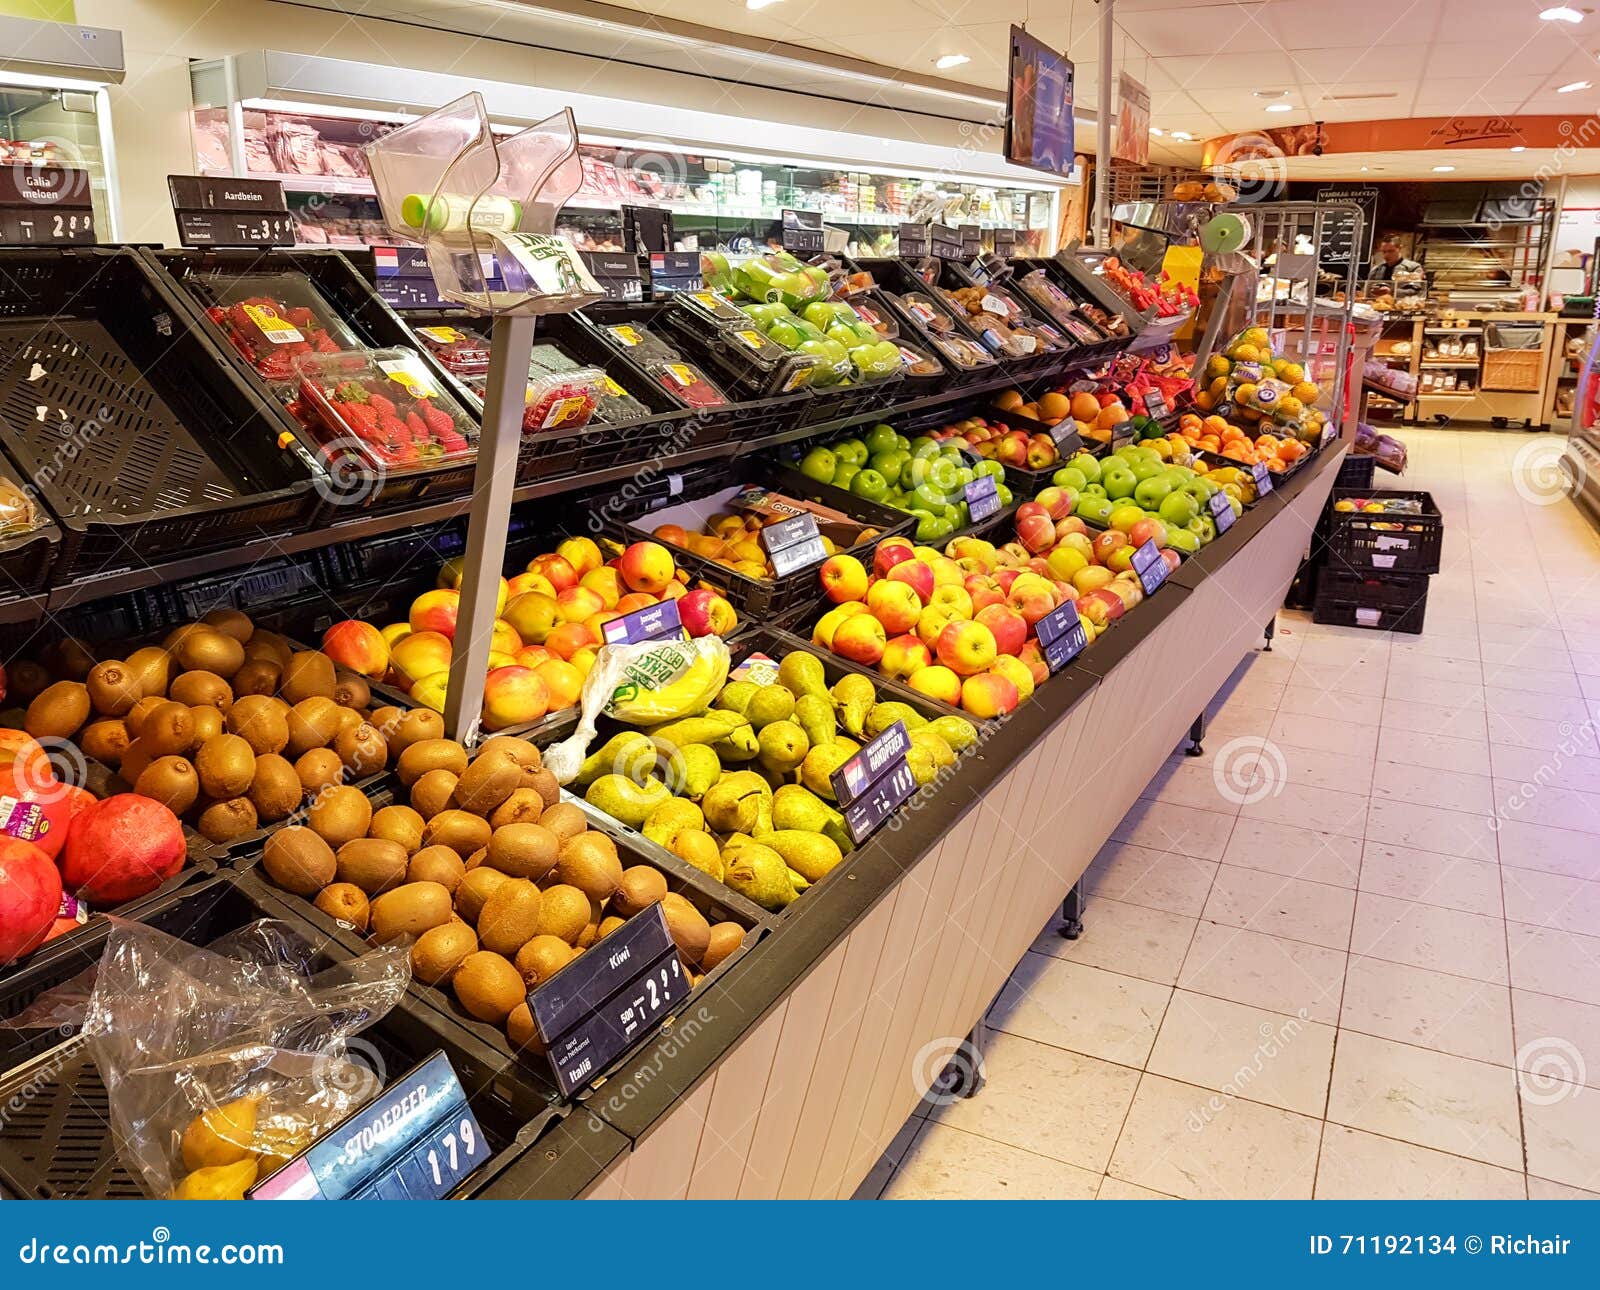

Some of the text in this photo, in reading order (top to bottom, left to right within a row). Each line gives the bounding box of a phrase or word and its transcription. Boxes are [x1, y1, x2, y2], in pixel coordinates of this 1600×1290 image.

[26, 176, 51, 188] Galia
[22, 189, 58, 200] meloen
[224, 191, 263, 201] Aardbeien
[411, 259, 427, 268] Rode
[893, 765, 914, 797] 169
[609, 945, 632, 970] Kiwi
[620, 1007, 635, 1025] 500
[567, 1036, 591, 1060] herkomst
[568, 1057, 592, 1084] Italië
[426, 1118, 476, 1186] 179
